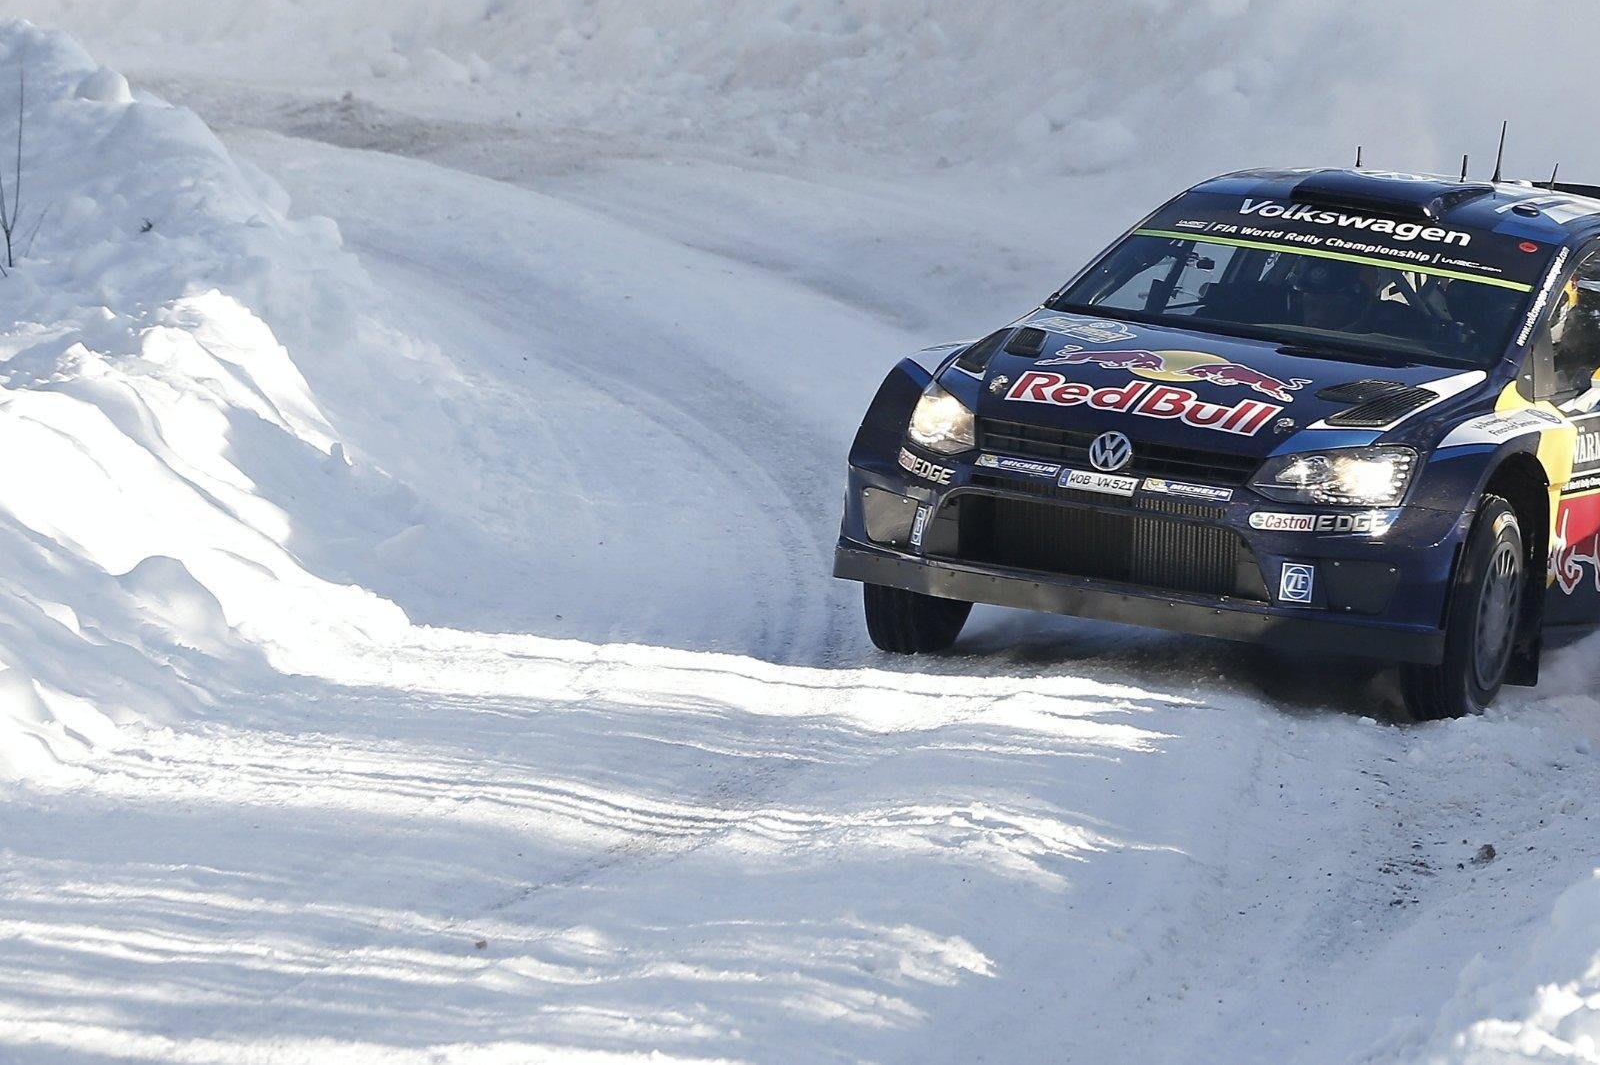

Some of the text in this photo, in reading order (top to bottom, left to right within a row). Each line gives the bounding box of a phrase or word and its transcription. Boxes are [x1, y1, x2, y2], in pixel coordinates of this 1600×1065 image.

[1239, 198, 1471, 247] Volkswagen
[1213, 223, 1238, 234] FIA
[1240, 226, 1284, 239] World
[1284, 231, 1324, 246] Rally
[1325, 237, 1430, 263] Championship
[1005, 371, 1284, 436] Red Bull
[914, 457, 956, 486] EDGE
[1000, 458, 1057, 473] MICHELIN
[1069, 474, 1092, 486] WOB
[1170, 483, 1229, 498] MICHELIN
[1265, 514, 1389, 532] Castrol EDGE
[1286, 572, 1310, 592] ZF
